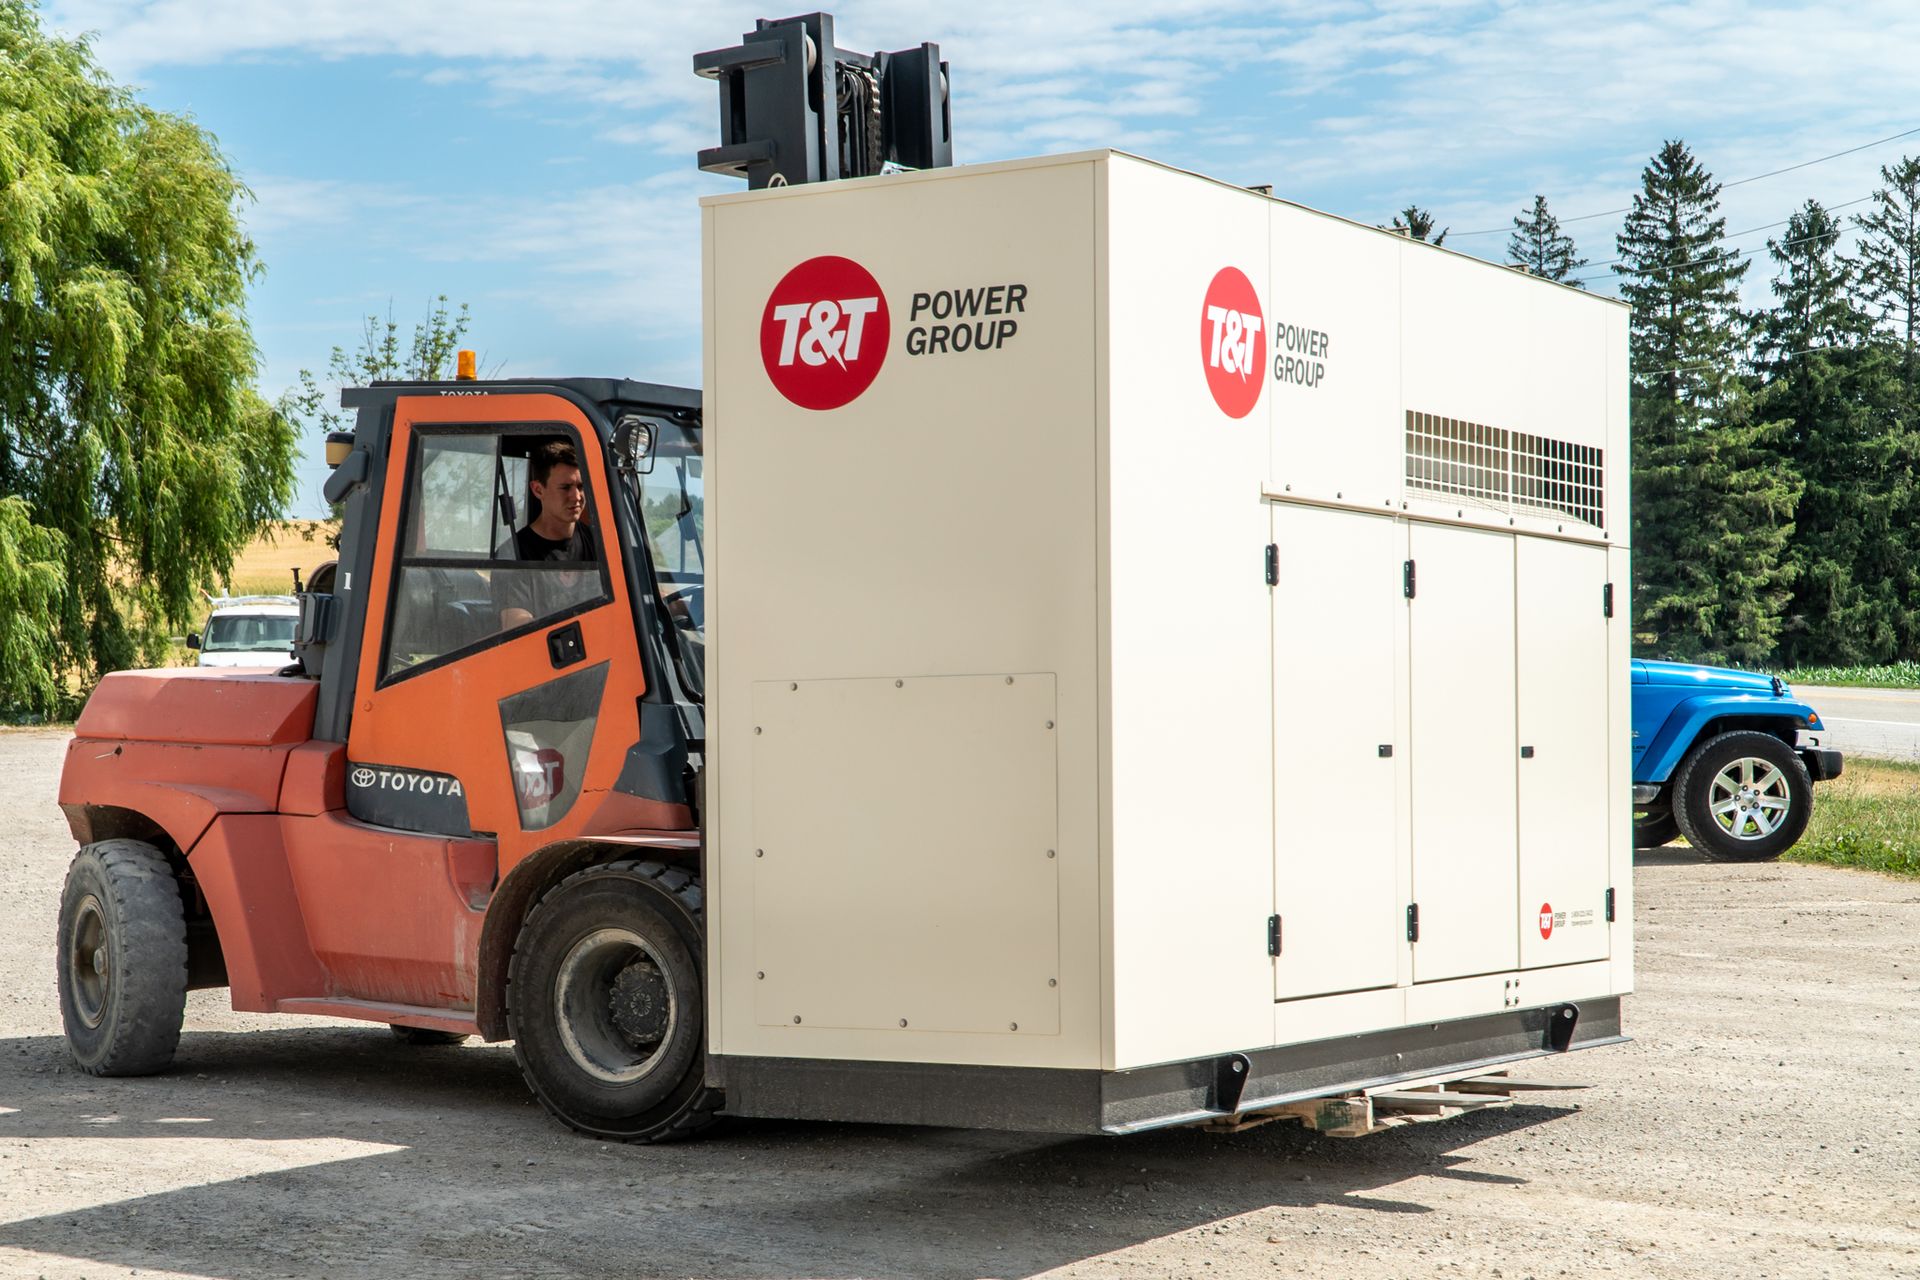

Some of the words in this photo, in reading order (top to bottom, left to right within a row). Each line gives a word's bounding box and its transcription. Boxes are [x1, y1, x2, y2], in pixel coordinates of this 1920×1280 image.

[910, 284, 1028, 322] POWER
[773, 297, 878, 372] T&T
[906, 320, 1018, 356] GROUP
[1207, 304, 1262, 385] T&T
[1276, 322, 1329, 359] POWER
[1274, 354, 1325, 388] GROUP
[343, 572, 352, 590] 1
[379, 771, 462, 797] TOYOTA
